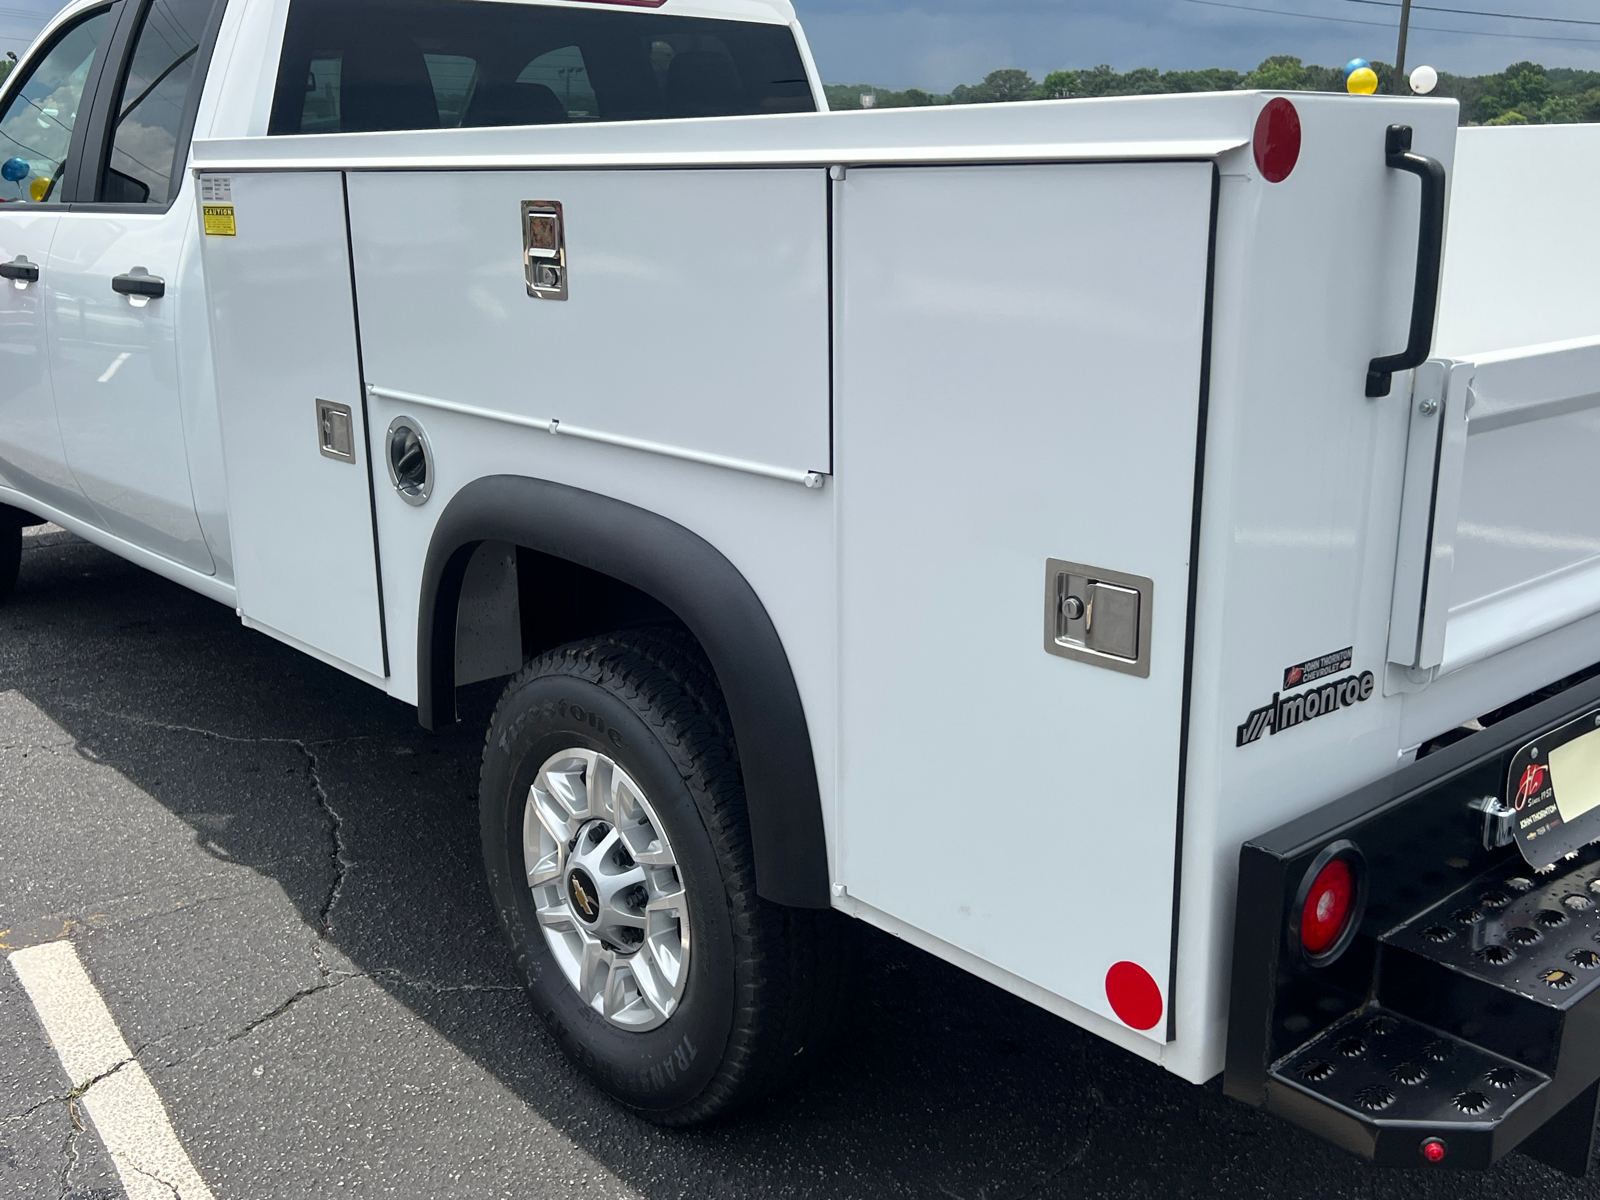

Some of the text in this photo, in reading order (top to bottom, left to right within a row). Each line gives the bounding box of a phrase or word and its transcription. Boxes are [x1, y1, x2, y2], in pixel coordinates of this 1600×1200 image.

[1302, 662, 1340, 682] CHEVROLET
[1303, 650, 1352, 673] JOHN THORNTON
[1280, 671, 1374, 730] monroe
[1519, 815, 1533, 829] JOHN
[1531, 803, 1557, 823] THORNTON
